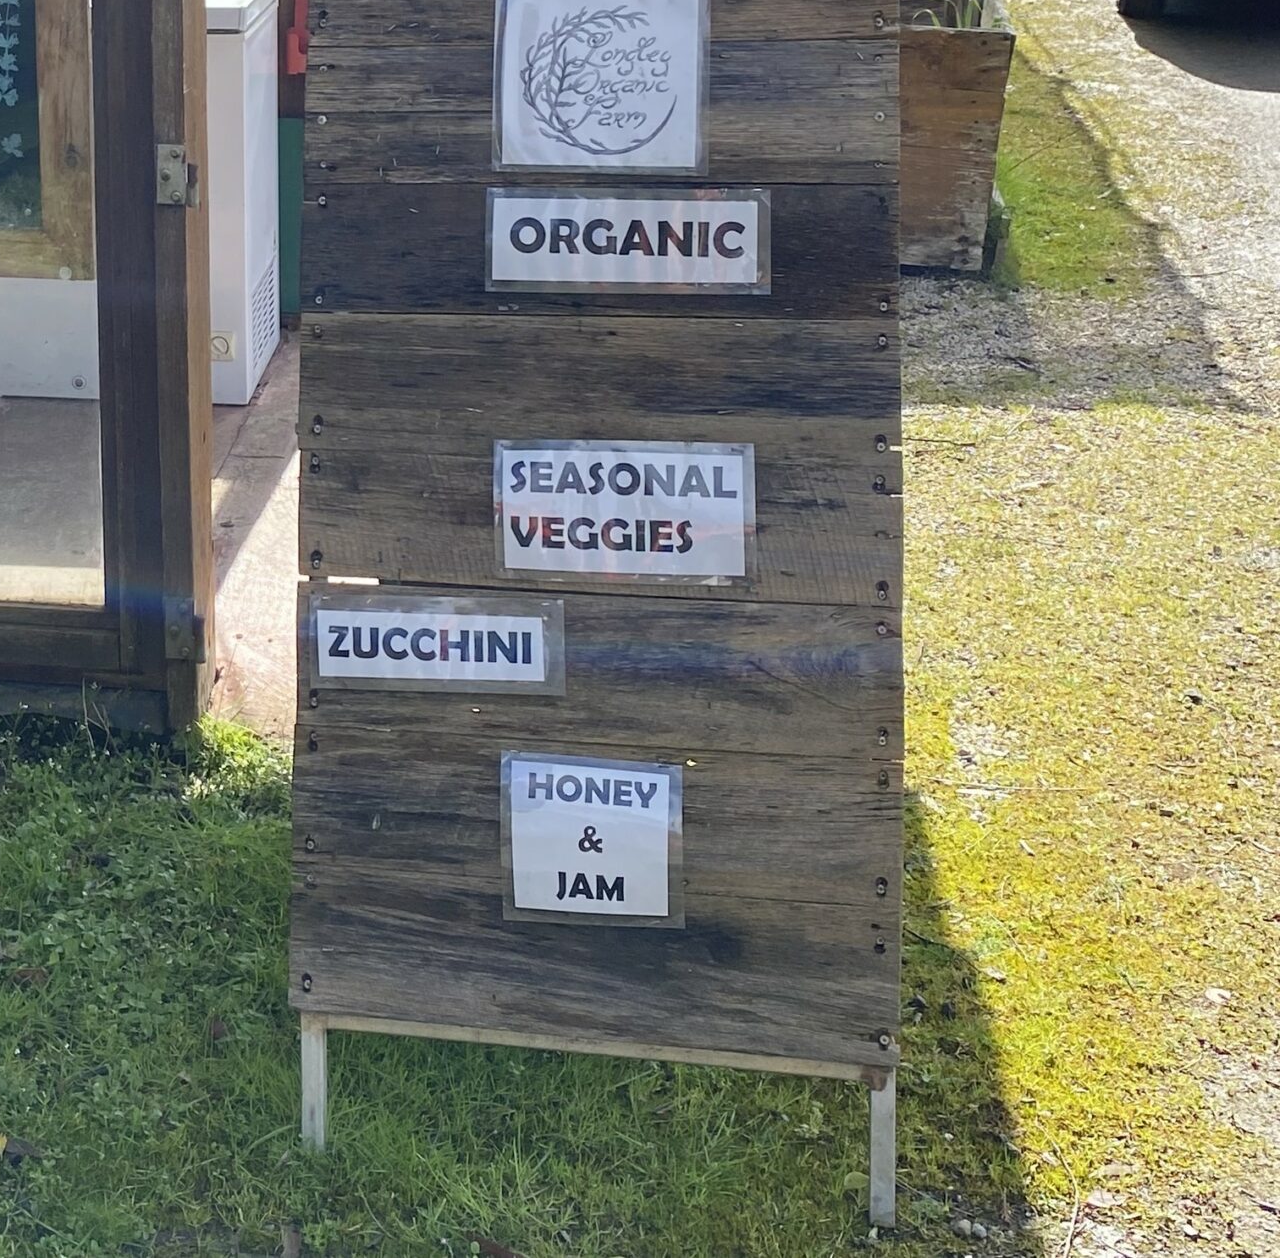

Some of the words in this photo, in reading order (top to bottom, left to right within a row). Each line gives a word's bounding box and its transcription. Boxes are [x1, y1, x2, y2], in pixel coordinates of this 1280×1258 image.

[569, 31, 673, 77] Longley
[567, 69, 671, 110] Organic
[564, 95, 648, 131] Farm
[509, 216, 746, 260] ORGANIC
[510, 460, 738, 499] SEASONAL
[510, 516, 694, 554] VEGGIES
[328, 625, 532, 664] ZUCCHINI
[527, 772, 658, 809] HONEY
[578, 825, 603, 854] &
[556, 871, 625, 902] JAM
